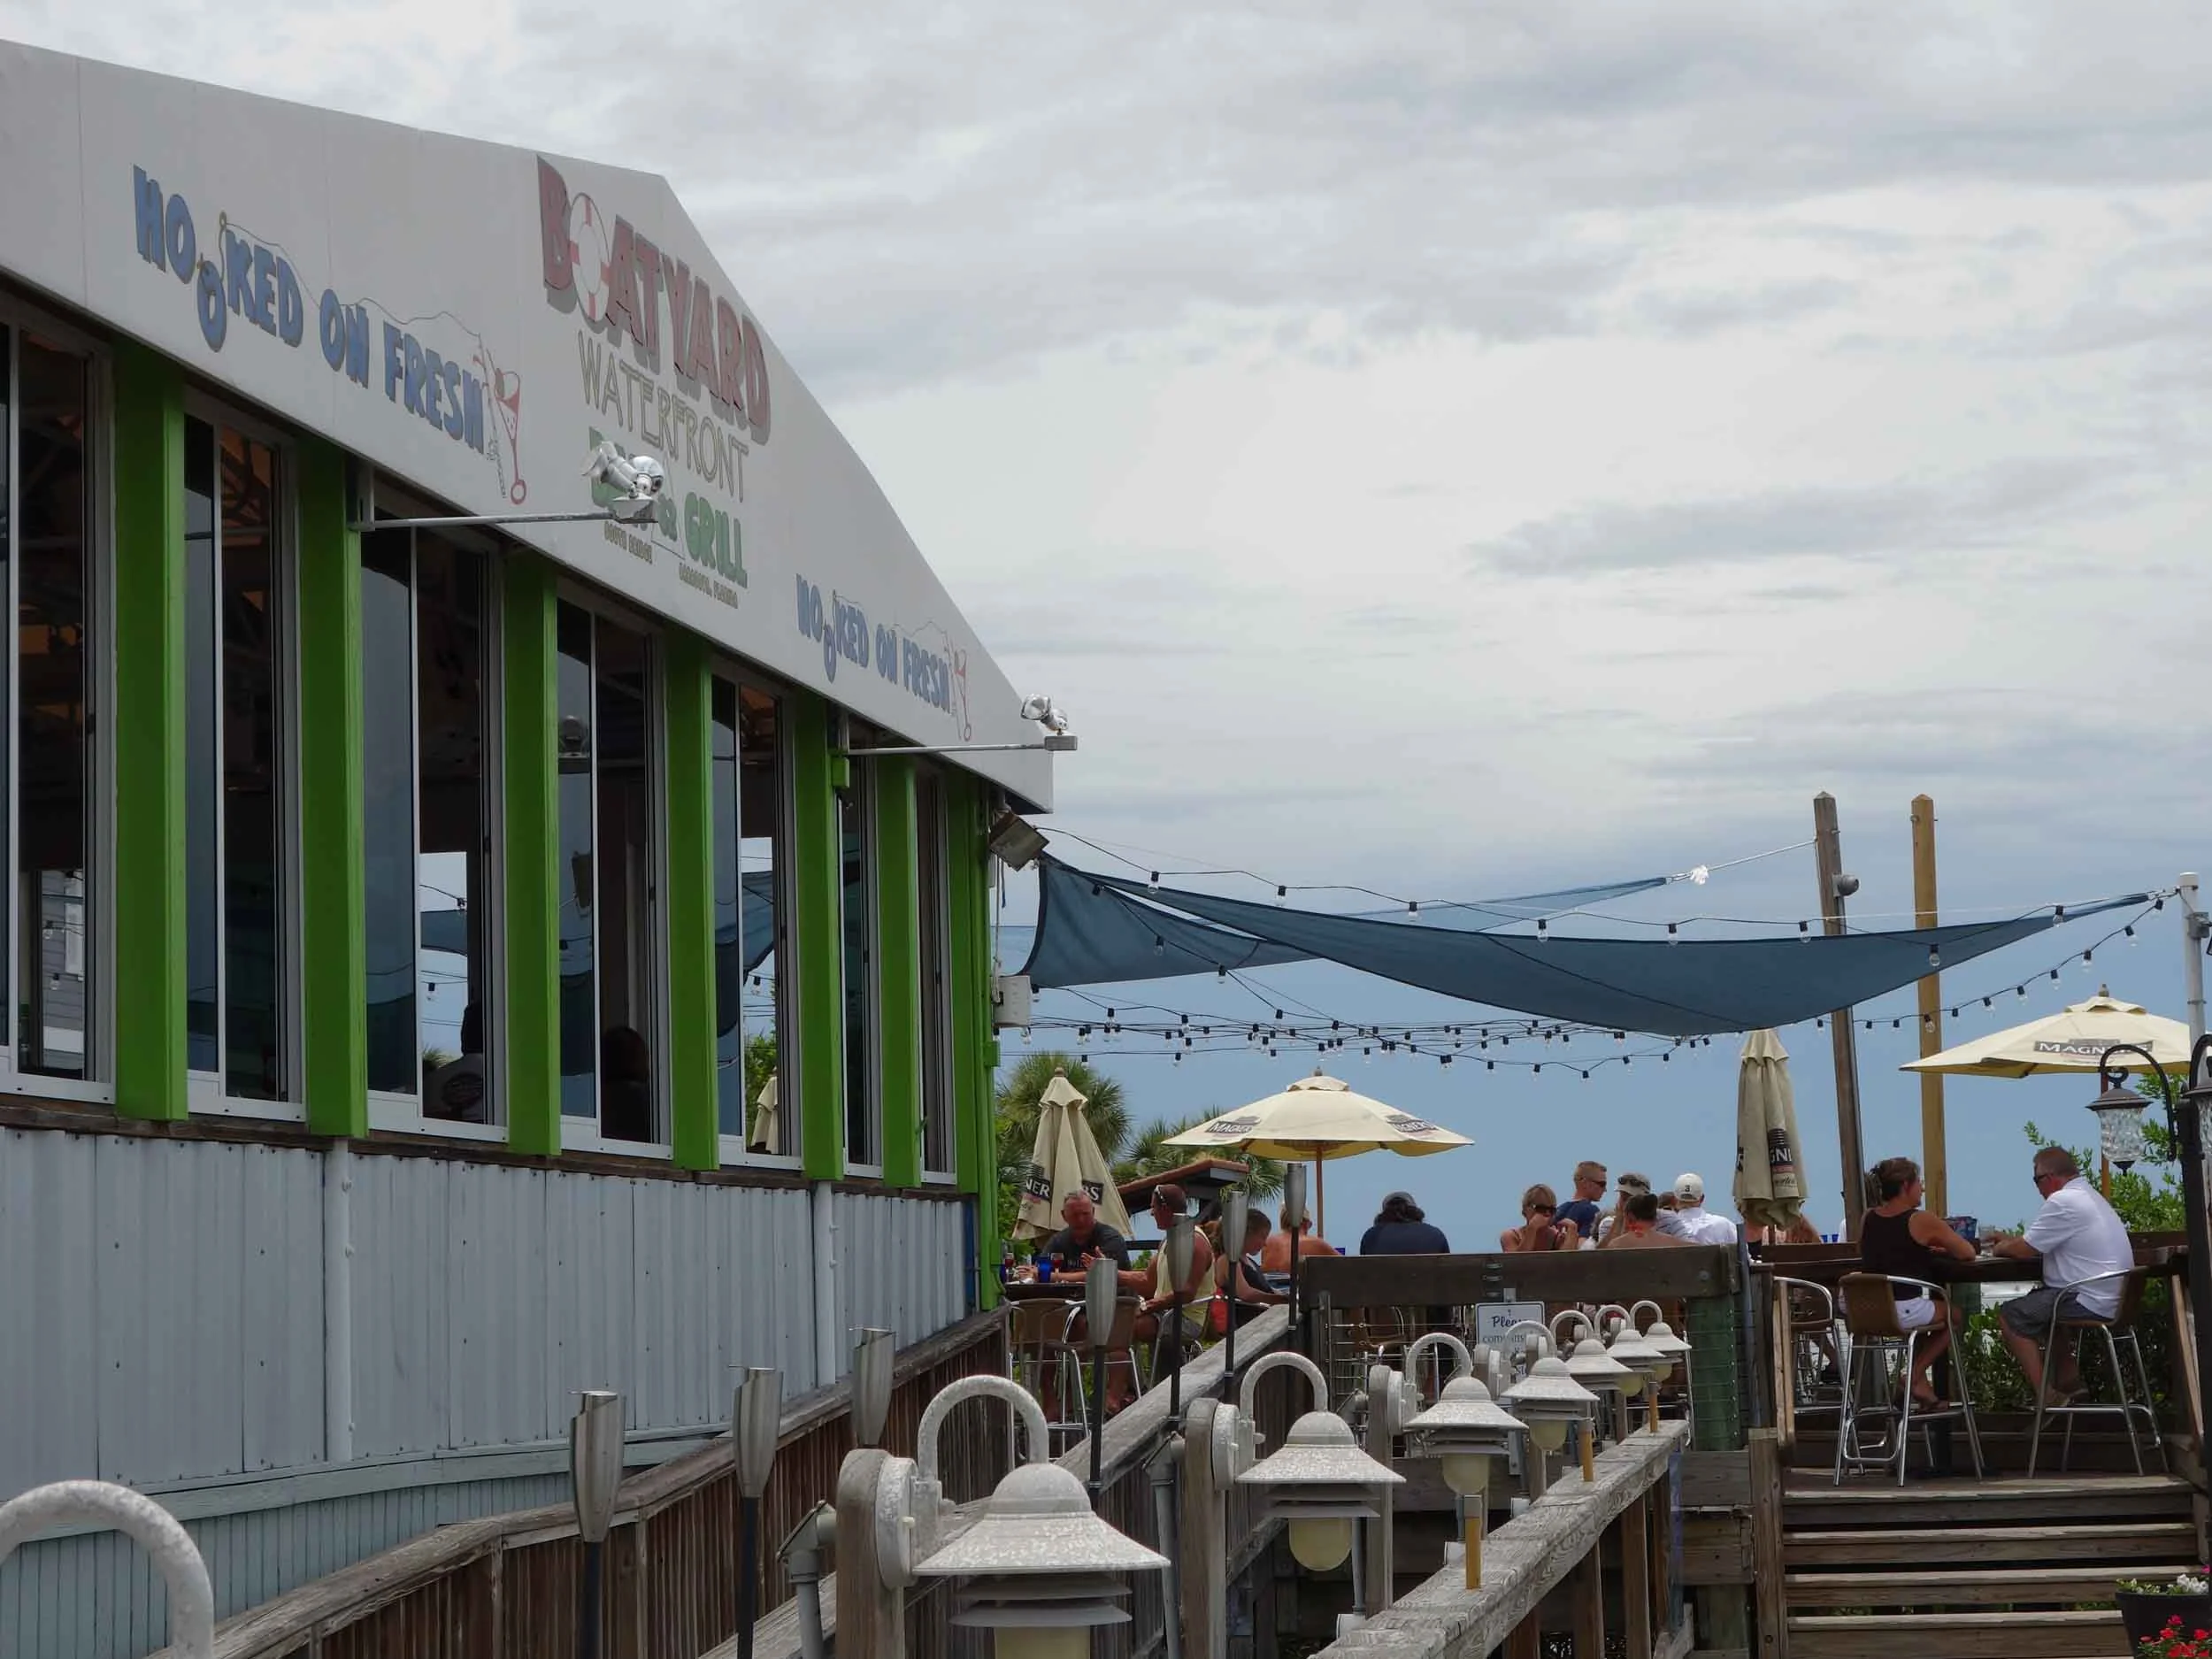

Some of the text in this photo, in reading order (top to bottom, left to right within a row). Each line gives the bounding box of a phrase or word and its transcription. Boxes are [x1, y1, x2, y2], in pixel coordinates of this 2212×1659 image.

[133, 164, 485, 455] HOOKED ON FRESH
[536, 155, 772, 442] BOATYARD
[579, 330, 749, 503] WATERFRONT
[684, 492, 748, 588] GRILL
[796, 573, 950, 715] HOOKED ON FRESH
[2039, 1042, 2148, 1055] MAGNS
